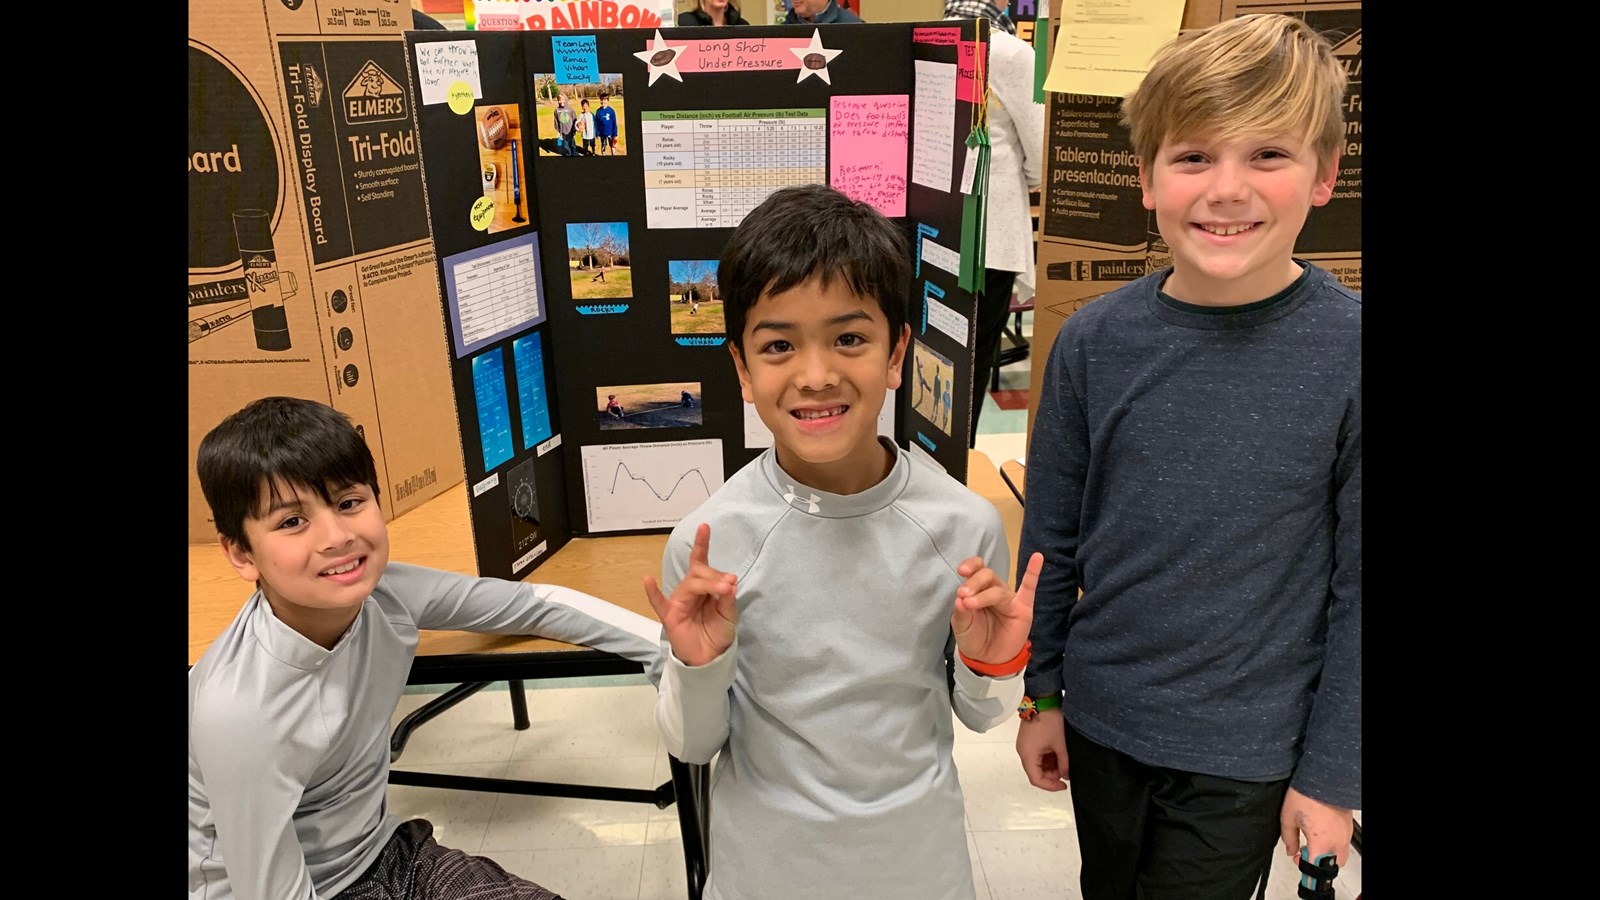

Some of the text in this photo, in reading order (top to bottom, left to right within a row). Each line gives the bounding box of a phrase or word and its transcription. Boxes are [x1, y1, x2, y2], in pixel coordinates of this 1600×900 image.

[481, 18, 519, 27] QUESTION
[420, 47, 430, 56] We
[699, 41, 767, 58] Long Shot
[699, 57, 784, 70] Under Pressure
[567, 73, 591, 83] Rocky
[350, 97, 402, 118] ELMER'S
[835, 111, 860, 120] Does
[1061, 110, 1083, 118] Tablero
[1060, 120, 1089, 129] Superficie
[1073, 130, 1109, 139] Permanente
[348, 130, 415, 162] Tri-Fold
[289, 63, 328, 245] Tri-Fold Display Board
[1055, 146, 1098, 164] Tablero
[357, 163, 419, 178] Sturdy corrugated board
[359, 178, 399, 190] Smooth surface
[1053, 169, 1142, 188] presentaciones
[361, 190, 394, 202] Self Standing
[1056, 198, 1078, 207] Surface
[1055, 208, 1100, 219] Auto permanent
[1098, 261, 1144, 278] painters
[188, 282, 246, 305] painters
